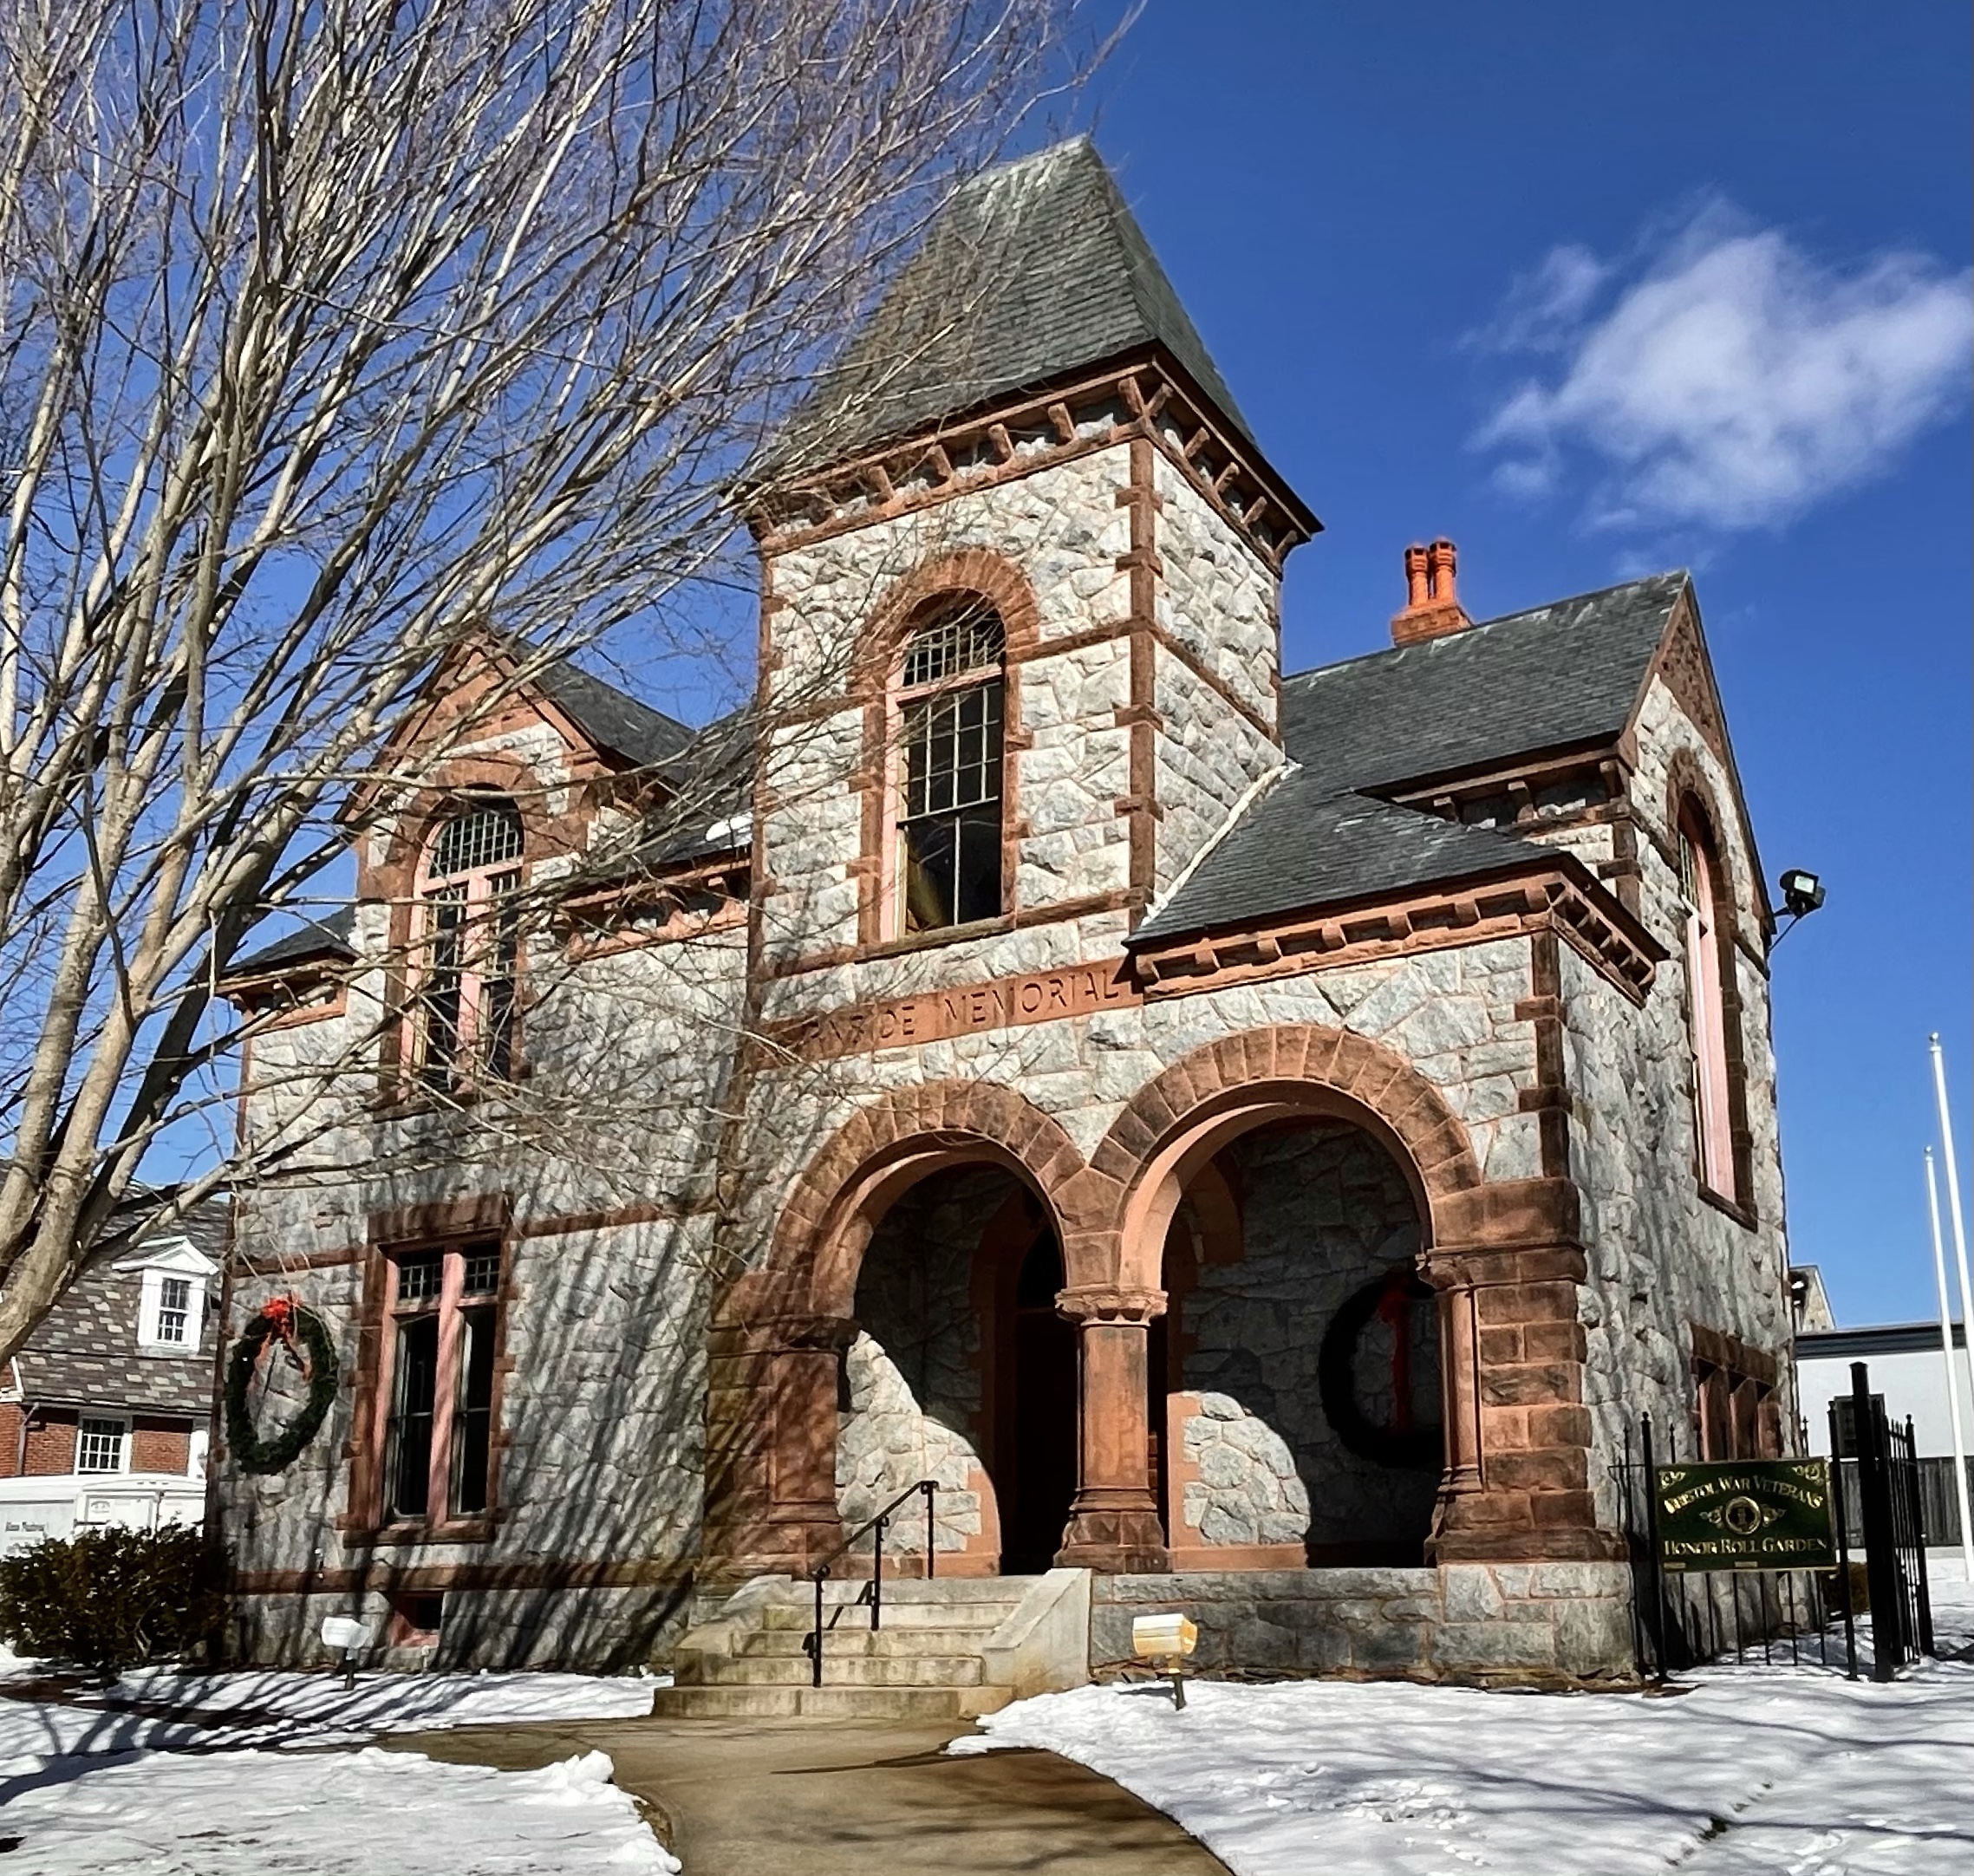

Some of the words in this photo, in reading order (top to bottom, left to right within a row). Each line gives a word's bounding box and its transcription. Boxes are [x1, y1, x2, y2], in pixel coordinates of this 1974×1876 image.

[941, 968, 1119, 1026] MEMORIAL
[1717, 1475, 1751, 1492] WAR
[1753, 1475, 1824, 1509] VETERANS
[1665, 1540, 1717, 1556] HONOR
[1721, 1538, 1760, 1554] ROLL
[1762, 1536, 1827, 1553] GARDEN
